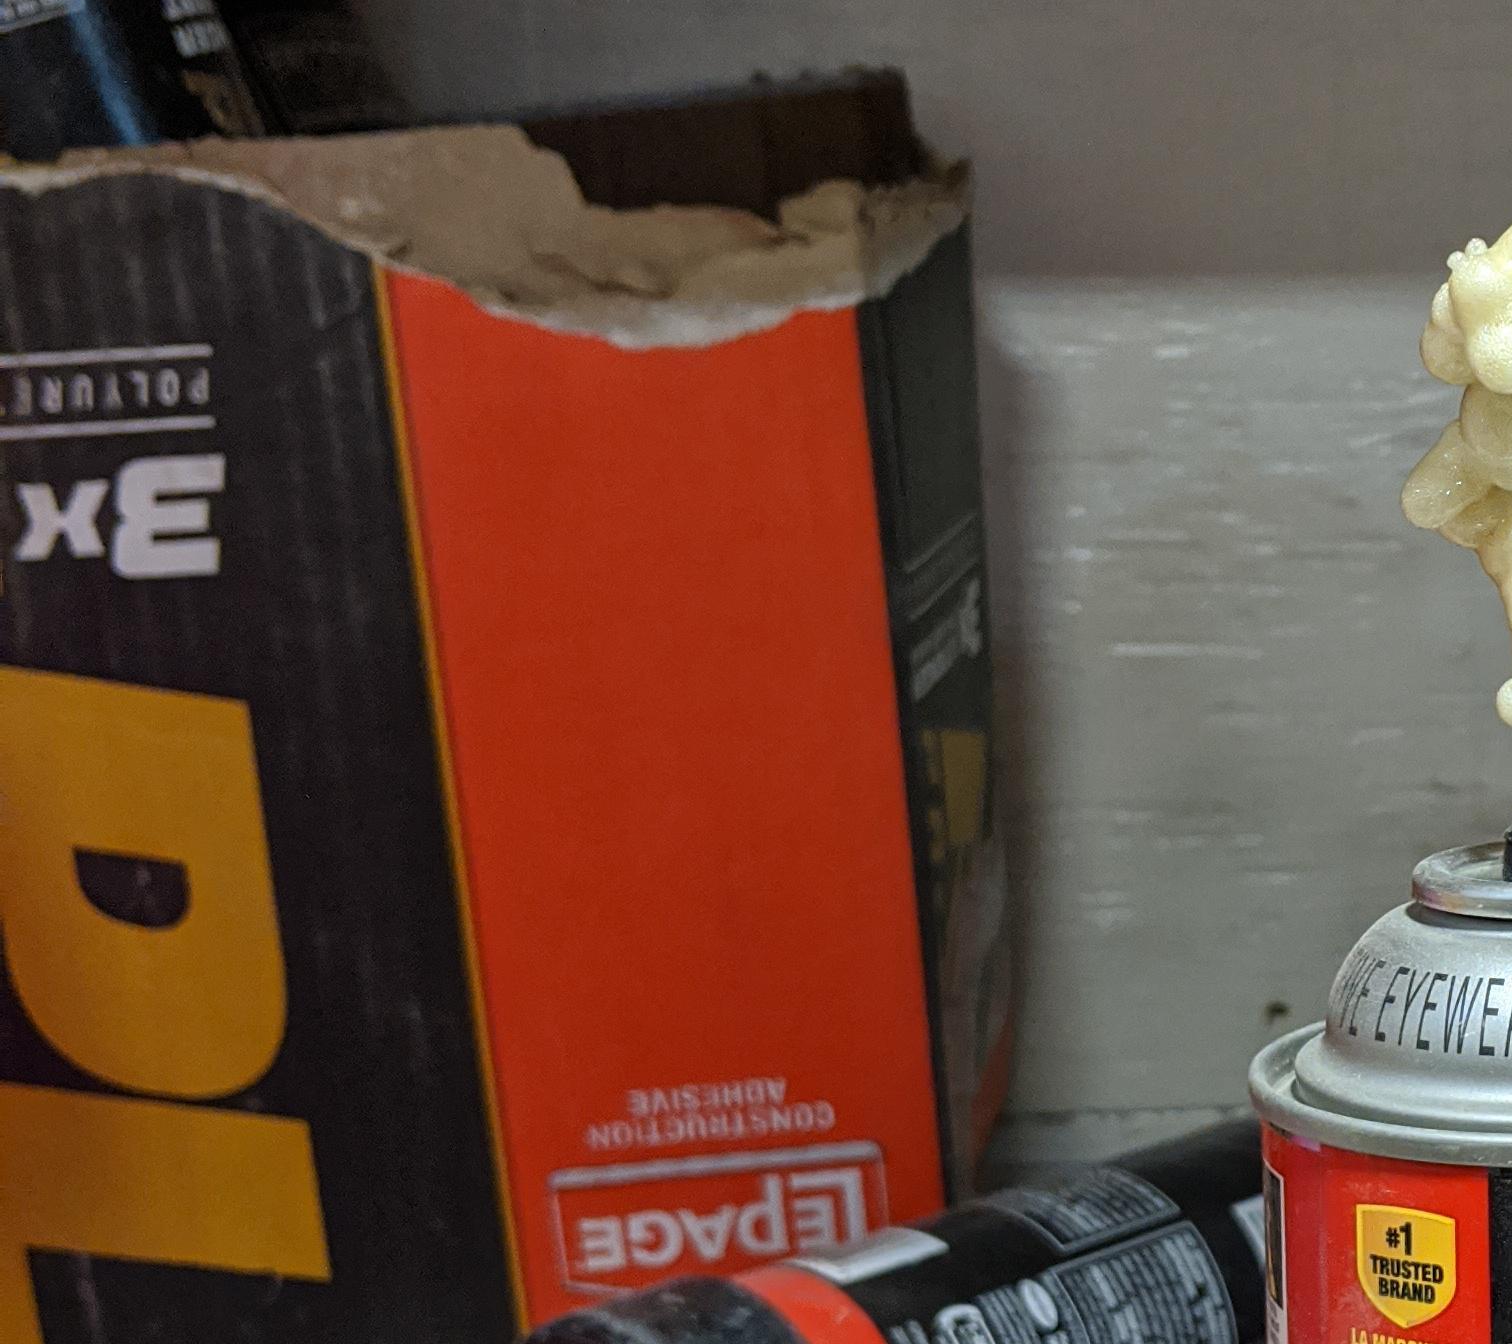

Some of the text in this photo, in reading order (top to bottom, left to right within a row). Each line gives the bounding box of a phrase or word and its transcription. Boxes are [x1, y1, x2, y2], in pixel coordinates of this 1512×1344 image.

[0, 367, 210, 418] POLYURE
[626, 1076, 788, 1117] ADHESIVE
[584, 1099, 837, 1151] CONSTRUCTION
[1385, 1221, 1413, 1256] #1
[1369, 1253, 1445, 1285] TRUSTED
[1378, 1277, 1436, 1305] BRAND
